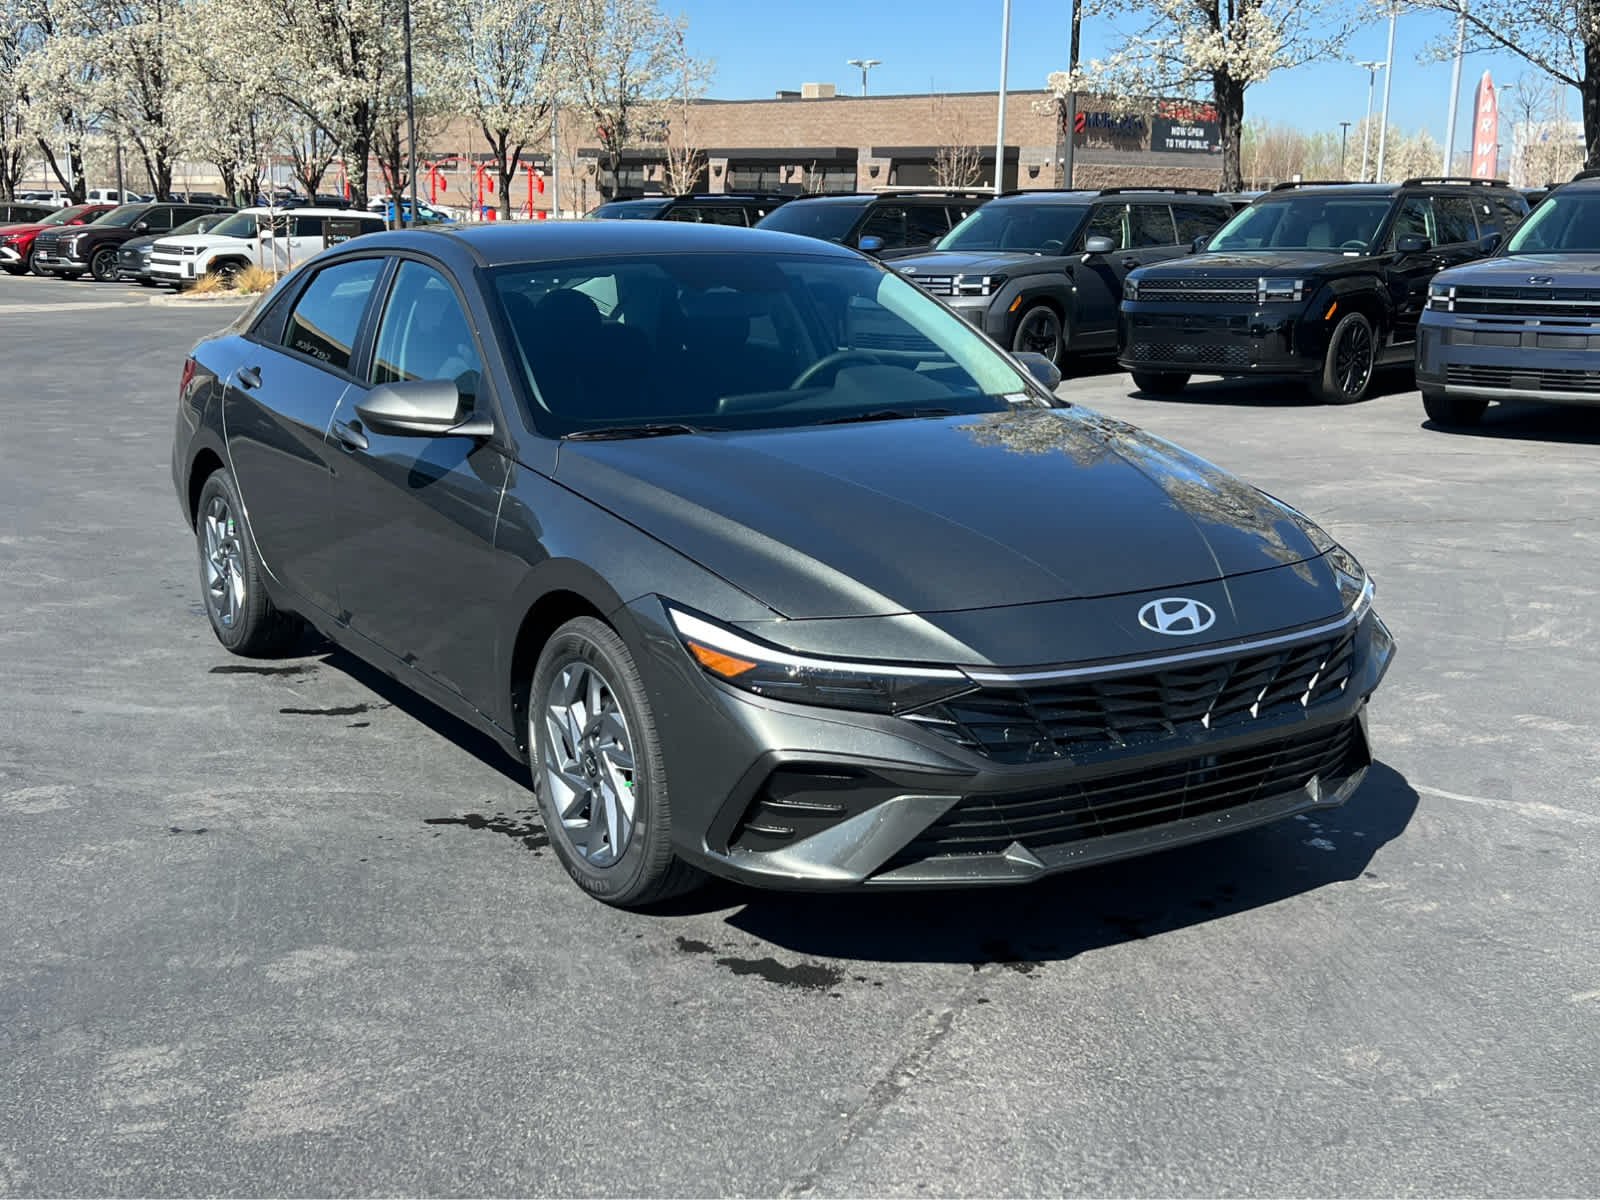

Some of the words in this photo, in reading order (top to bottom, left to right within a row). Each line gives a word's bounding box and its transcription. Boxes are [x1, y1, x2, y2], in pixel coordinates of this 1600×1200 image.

[1171, 126, 1187, 136] NOW
[1187, 126, 1204, 137] OPEN
[1165, 138, 1174, 148] TO
[1175, 138, 1186, 149] THE
[1187, 139, 1210, 149] PUBLIC
